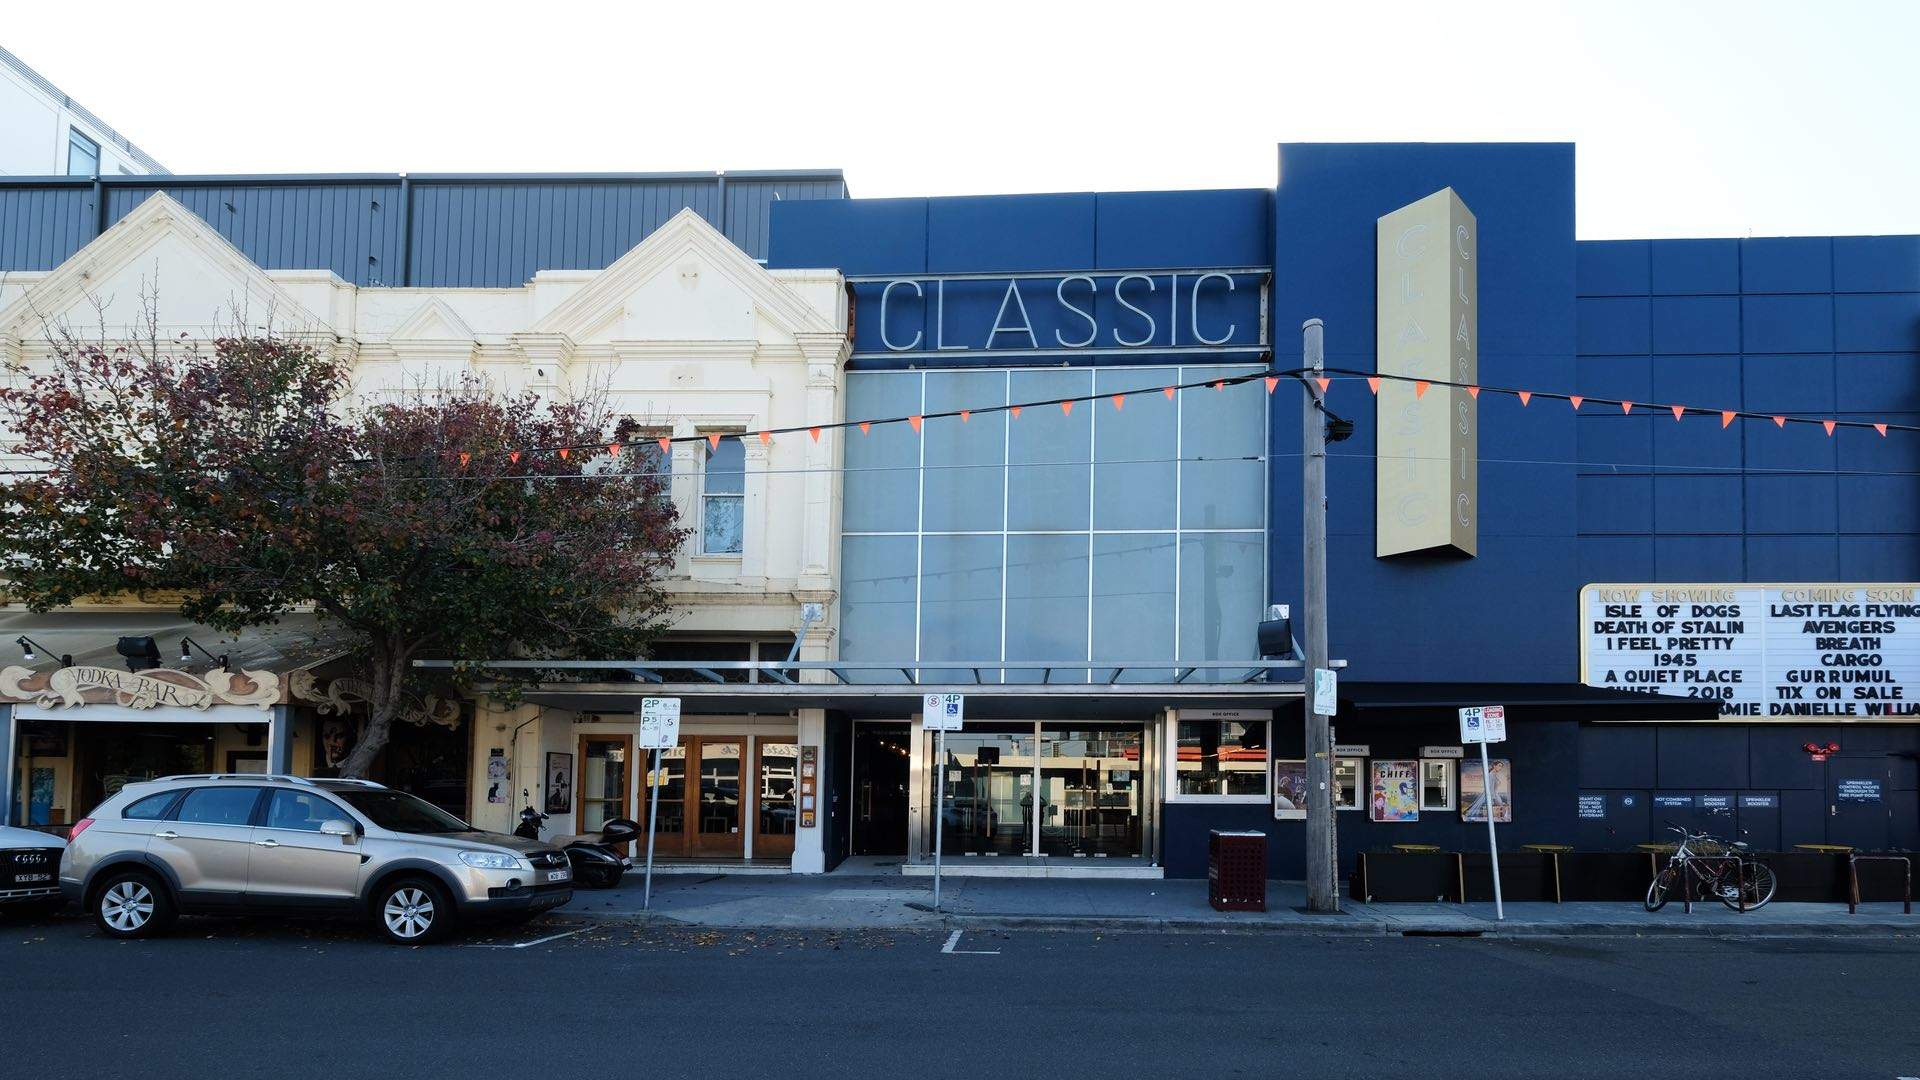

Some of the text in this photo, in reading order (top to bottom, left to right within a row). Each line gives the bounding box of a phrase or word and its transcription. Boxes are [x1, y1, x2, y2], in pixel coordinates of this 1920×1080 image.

[880, 272, 1235, 351] CLASSIC
[1599, 589, 1736, 603] NOW SHOWING
[1781, 588, 1914, 603] COMING SOON
[1605, 605, 1741, 618] ISLE OF DOGS
[1771, 604, 1920, 618] LAST FLAG FLYING
[1594, 621, 1744, 634] DEATH OF STALIN
[1802, 620, 1896, 634] AVENGERS
[1607, 637, 1734, 650] I FEEL PRETTY
[1816, 637, 1881, 650] BREATH
[1653, 653, 1698, 667] 1945
[1820, 653, 1883, 667] CARGO
[1604, 669, 1743, 683] A QUIET PLACE
[1786, 669, 1896, 683] GURRUMUL
[69, 668, 181, 706] VODKA BAR
[1687, 686, 1734, 699] 2018
[1776, 686, 1904, 700] TIX ON SALE
[644, 699, 660, 708] 2P
[945, 694, 961, 703] 4P
[1465, 708, 1481, 717] 4P
[1769, 702, 1857, 716] DANIELLE
[1380, 770, 1411, 778] CHIFF
